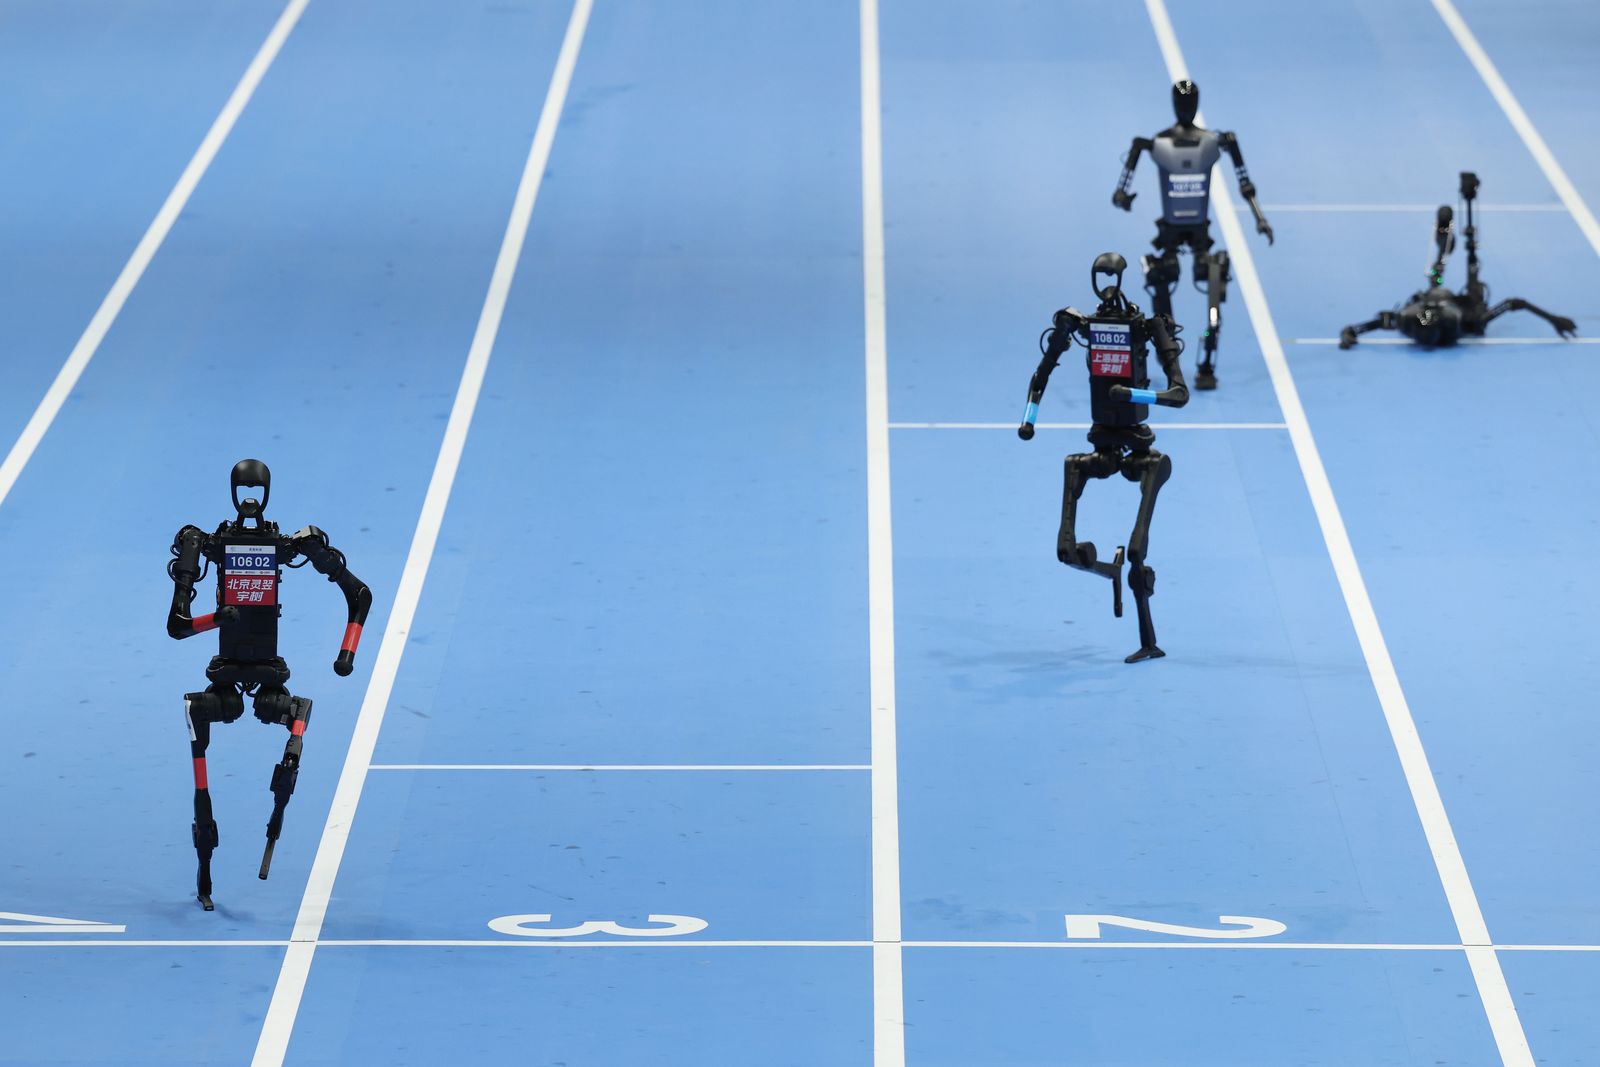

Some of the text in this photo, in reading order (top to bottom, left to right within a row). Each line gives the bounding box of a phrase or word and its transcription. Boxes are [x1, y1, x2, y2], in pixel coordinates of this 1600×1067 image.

[236, 591, 264, 602] 宇树
[488, 913, 709, 937] 3
[1064, 914, 1288, 939] 2
